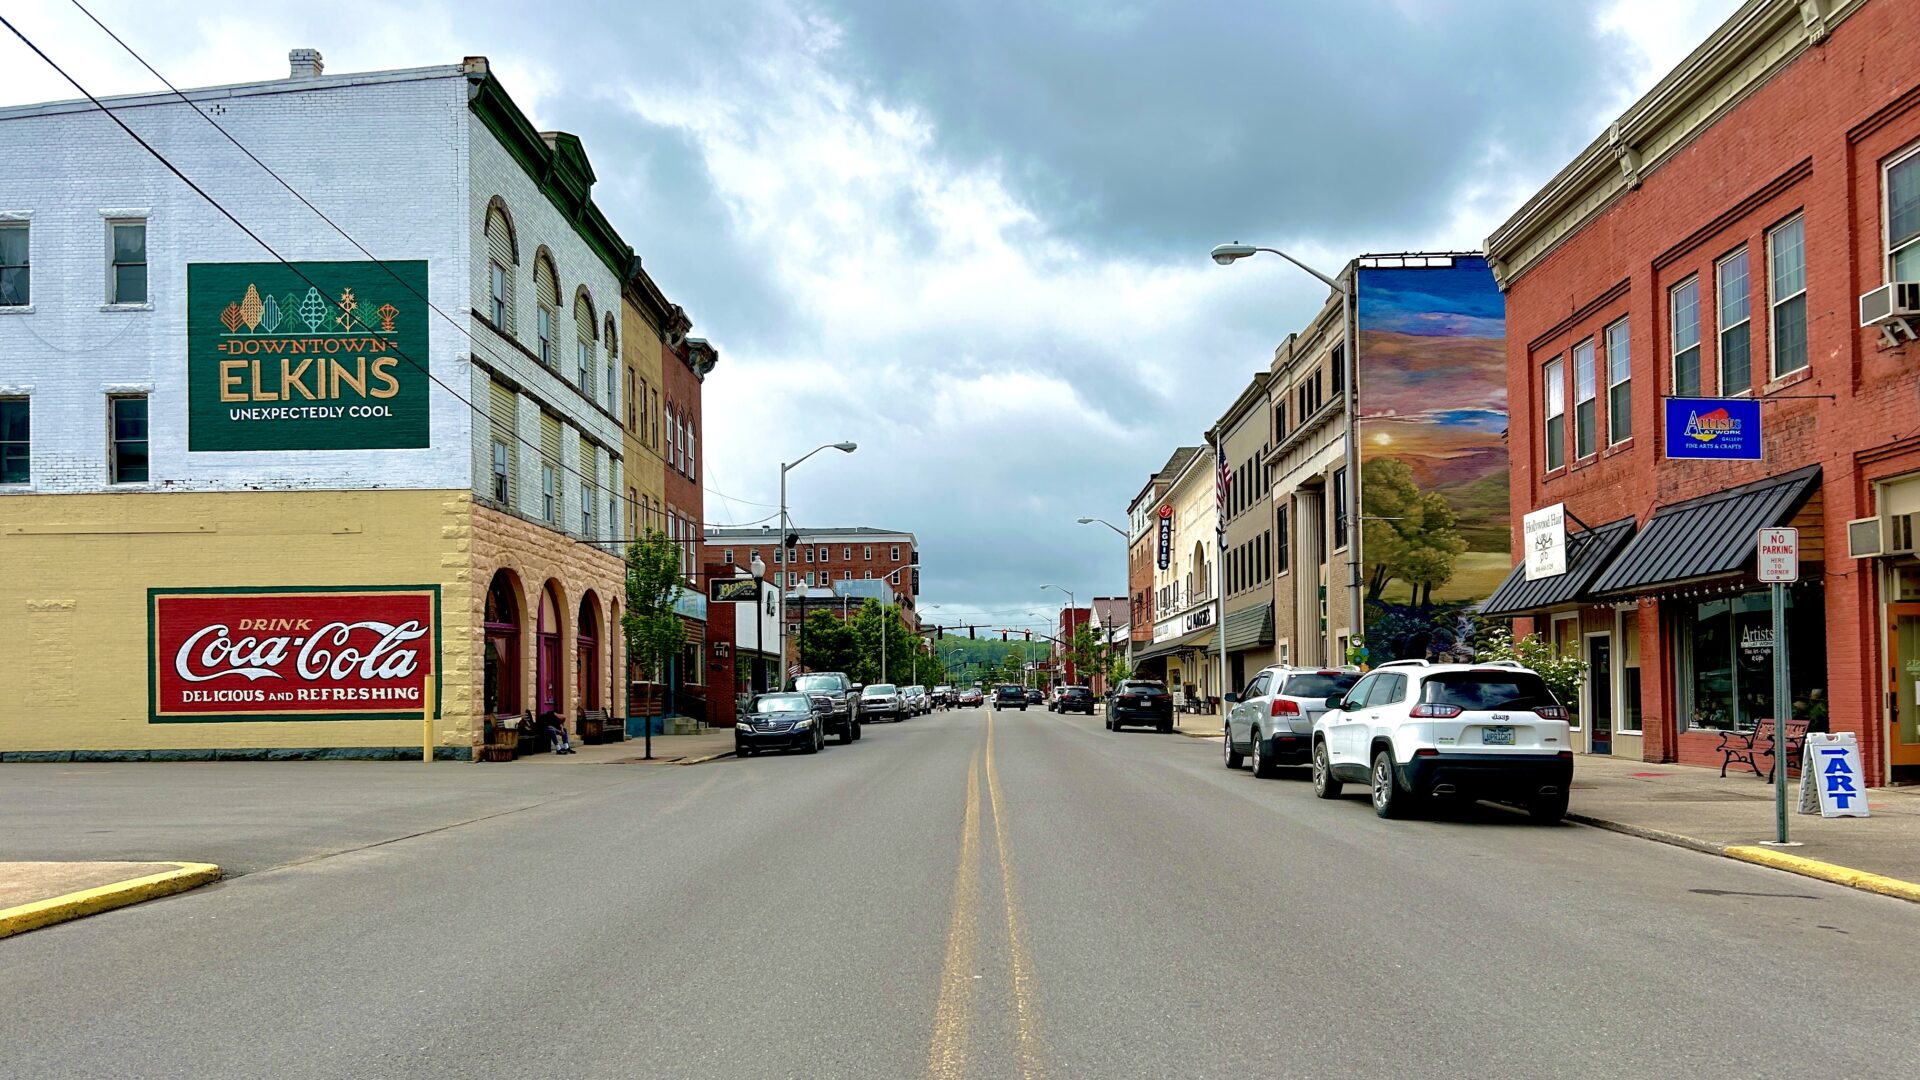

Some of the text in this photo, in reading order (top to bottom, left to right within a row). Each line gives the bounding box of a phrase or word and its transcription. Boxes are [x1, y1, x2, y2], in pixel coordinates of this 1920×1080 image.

[227, 338, 387, 355] DOWNTOWN
[219, 356, 400, 402] ELKINS
[229, 405, 393, 421] UNEXPECTEDLY COOL
[1684, 410, 1742, 436] Artists
[1161, 520, 1169, 568] MAGGIES
[1771, 535, 1784, 543] NO
[1763, 545, 1793, 554] PARKING
[238, 618, 313, 631] DRINK
[1742, 624, 1773, 641] Artists
[175, 619, 429, 682] Coca-Cola
[182, 687, 419, 703] DELICIOUS AND REFRESHING
[1824, 758, 1857, 808] ART
